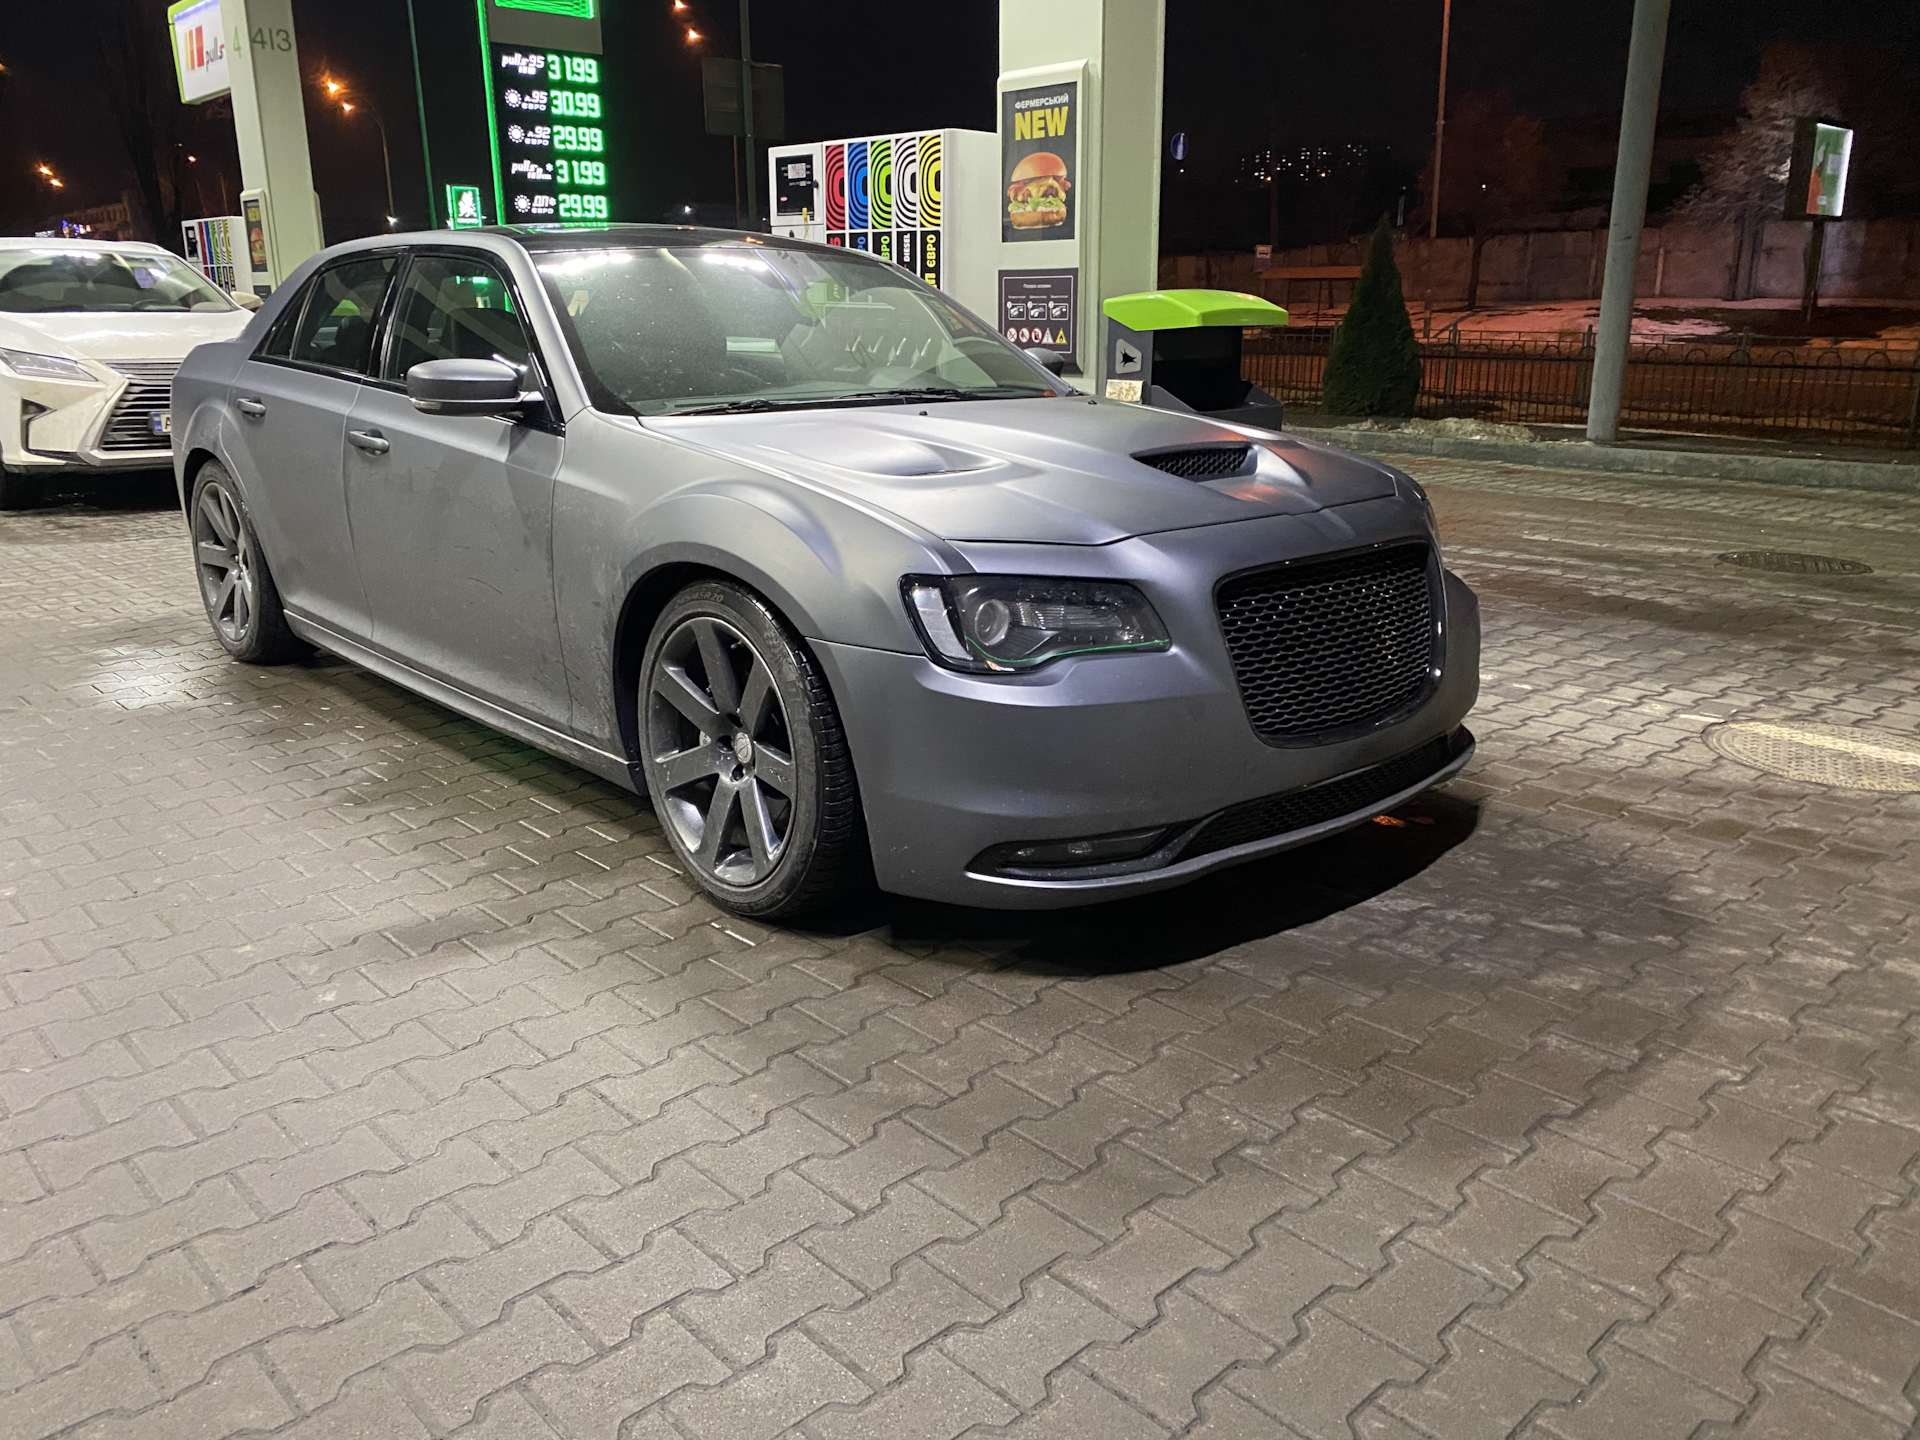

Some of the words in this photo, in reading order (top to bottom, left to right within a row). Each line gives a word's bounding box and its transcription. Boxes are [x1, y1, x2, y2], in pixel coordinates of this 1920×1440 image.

[550, 90, 601, 118] 30.99
[1014, 92, 1069, 109] ФЕРМЕРСЬКИЙ
[1014, 106, 1068, 141] NEW
[553, 125, 604, 152] 29.99
[558, 193, 608, 219] 29.99
[903, 233, 911, 262] DIESEL
[926, 234, 937, 268] ЄВРО
